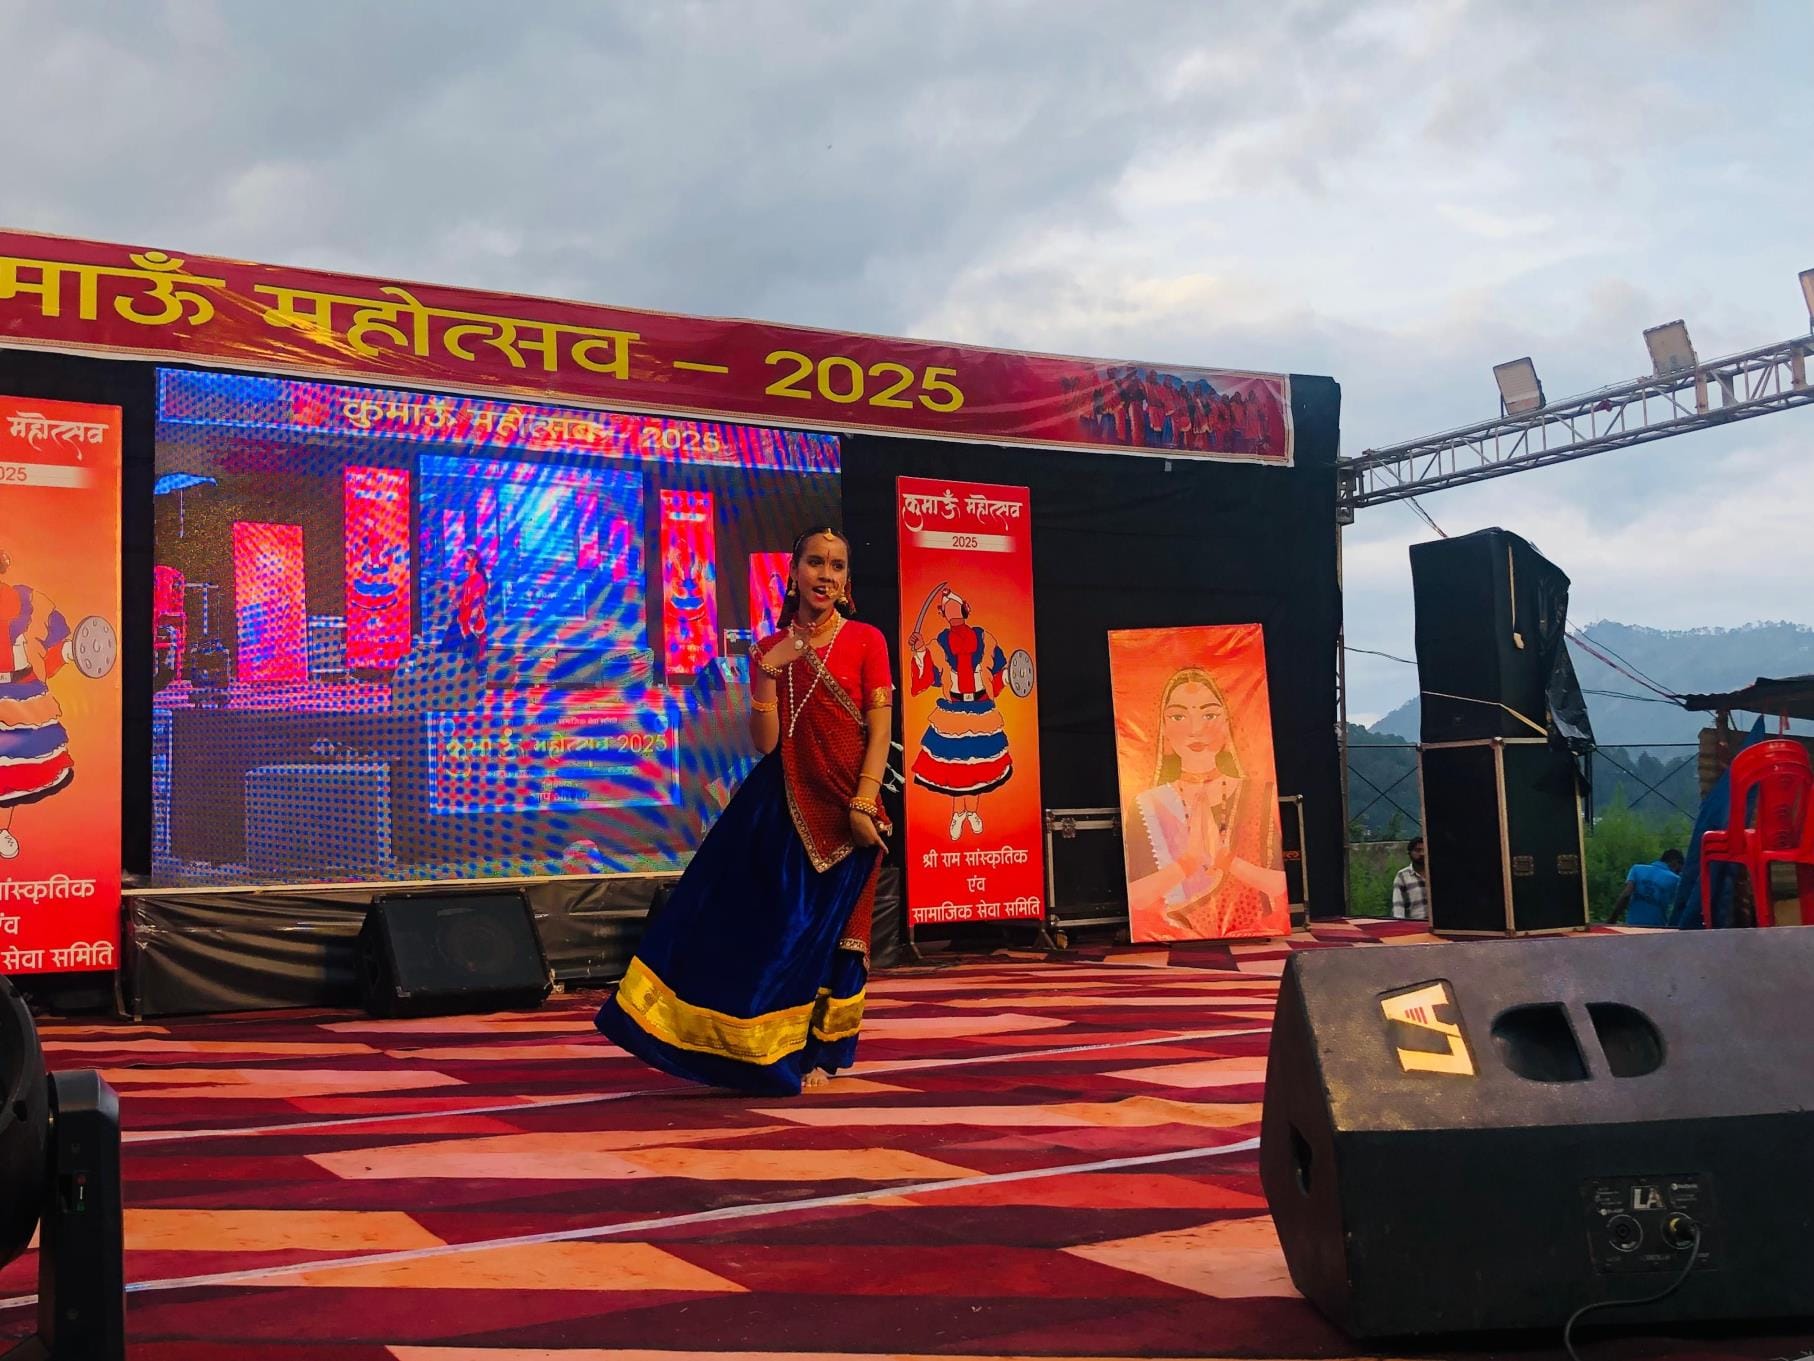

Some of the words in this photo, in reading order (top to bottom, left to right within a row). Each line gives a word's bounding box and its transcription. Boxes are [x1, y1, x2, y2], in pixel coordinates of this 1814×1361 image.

[254, 286, 640, 380] महोत्सव
[765, 350, 965, 413] 2025
[6, 410, 109, 461] महोत्सव
[641, 427, 721, 453] 2025
[901, 489, 961, 533] कुमाऊँ
[964, 494, 1024, 531] महोत्सव
[952, 536, 978, 548] 2025
[616, 734, 667, 753] 2025
[922, 849, 938, 868] श्री
[941, 852, 961, 868] राम
[964, 845, 1028, 869] सांस्कृतिक
[912, 901, 973, 923] सामाजिक
[976, 899, 1001, 918] सेवा
[1004, 896, 1041, 916] समिति
[1, 945, 45, 970] सेवा
[49, 940, 114, 968] समिति
[1634, 1187, 1664, 1209] LA
